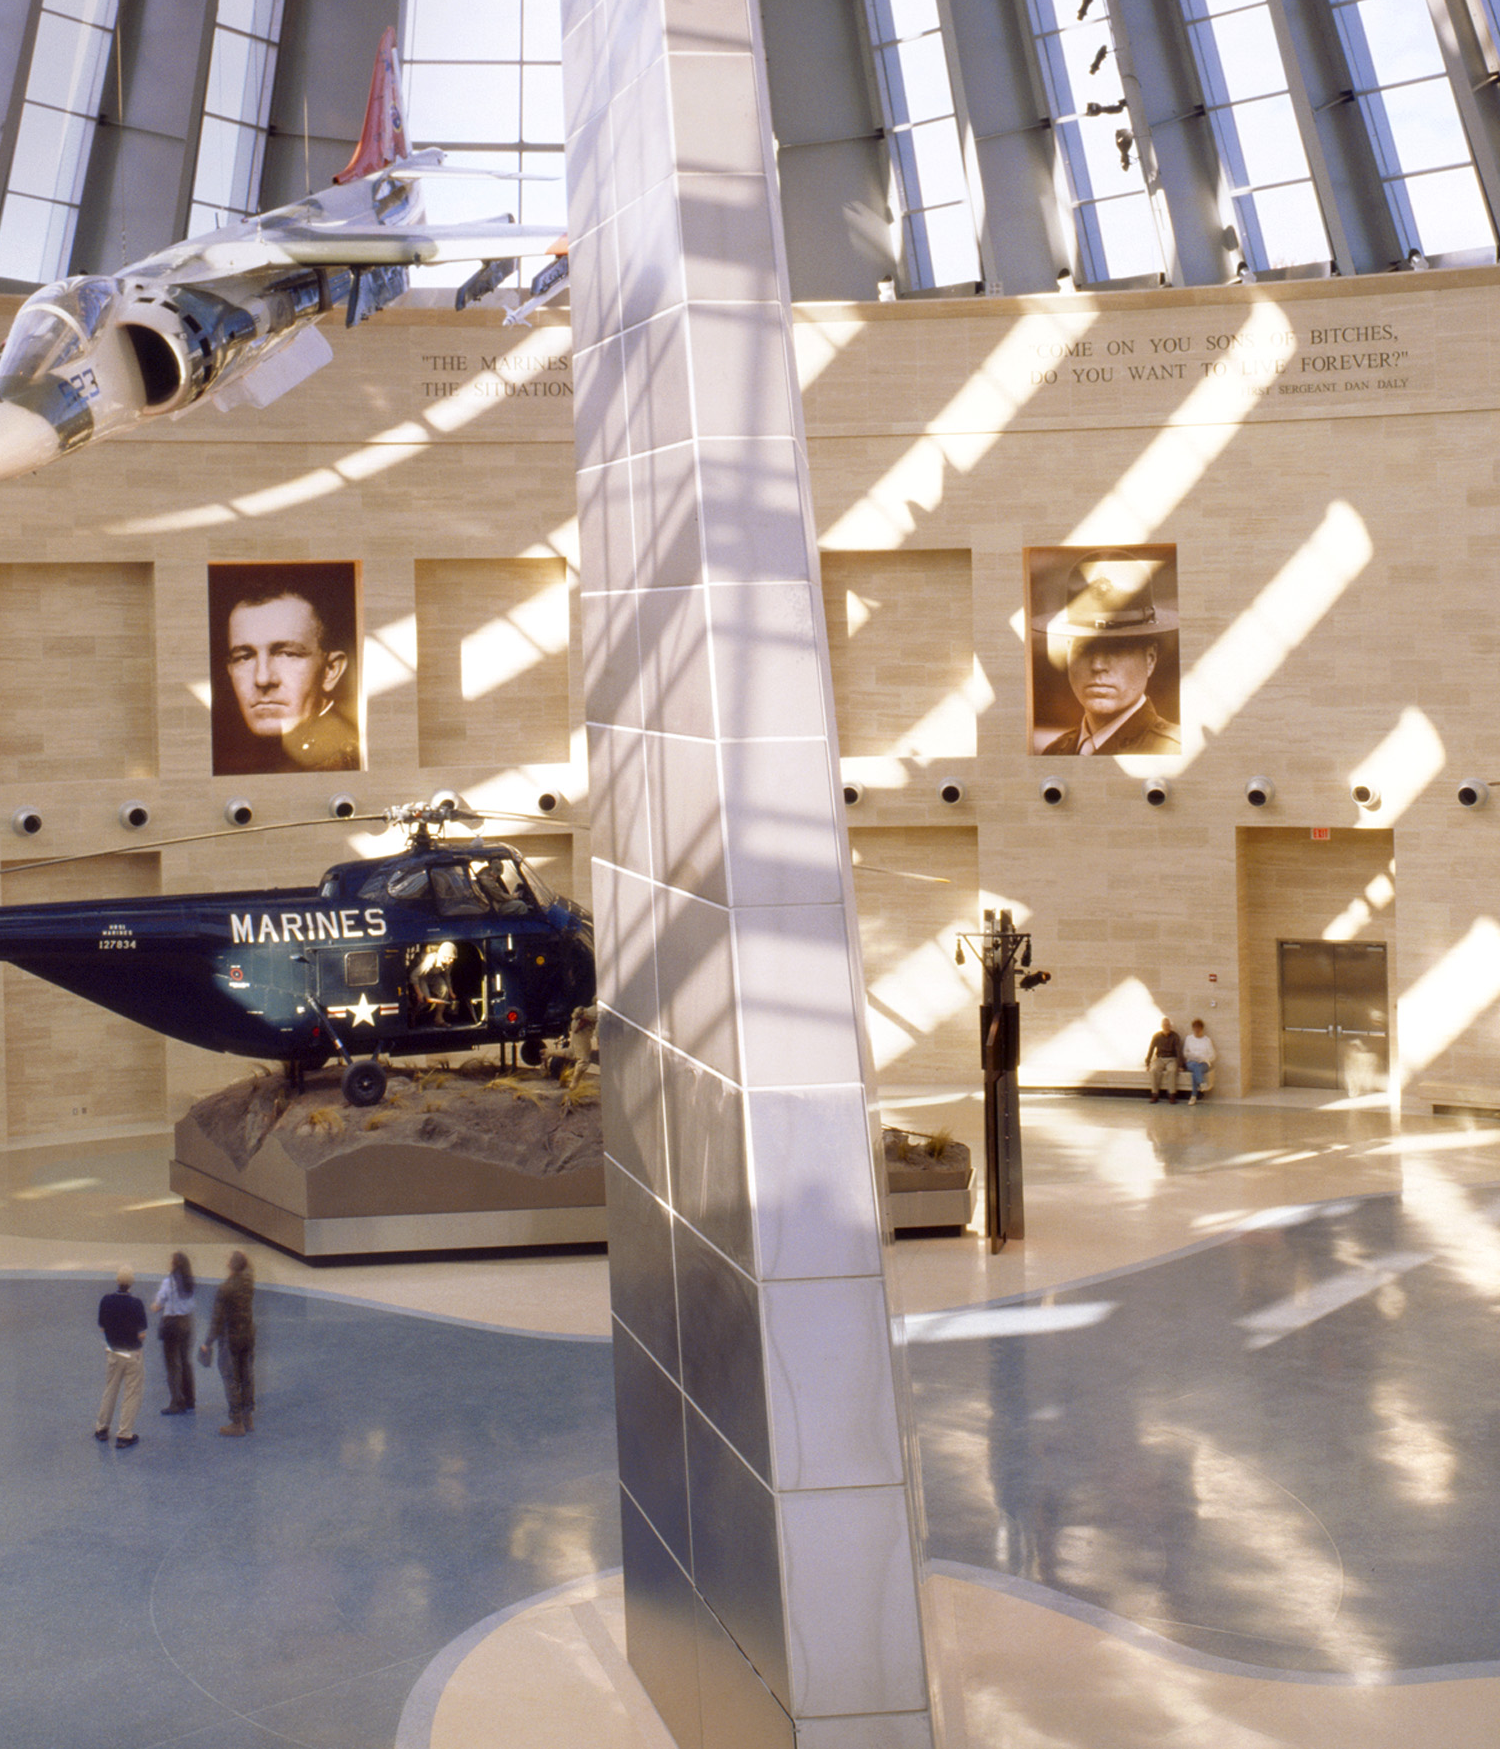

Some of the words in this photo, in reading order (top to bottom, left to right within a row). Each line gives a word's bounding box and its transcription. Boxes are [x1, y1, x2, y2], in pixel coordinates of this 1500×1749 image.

[1107, 339, 1135, 356] ON
[1150, 337, 1191, 354] YOU
[1206, 333, 1254, 351] SONS
[1271, 331, 1295, 347] OF
[1310, 324, 1398, 345] BITCHES,
[422, 355, 467, 371] "THE
[481, 355, 568, 371] MARINES
[1031, 369, 1058, 385] DO
[1072, 367, 1114, 383] YOU
[1128, 364, 1186, 381] WANT
[1200, 361, 1226, 378] TO
[1241, 358, 1287, 376] LIVE
[1301, 351, 1409, 372] FOREVER?"
[422, 382, 459, 396] THE
[474, 382, 574, 397] SITUATION
[1278, 382, 1338, 395] SERGEANT
[1344, 380, 1369, 392] DAN
[1377, 378, 1409, 390] DALY
[230, 908, 387, 943] MARINES
[99, 939, 136, 950] 127834
